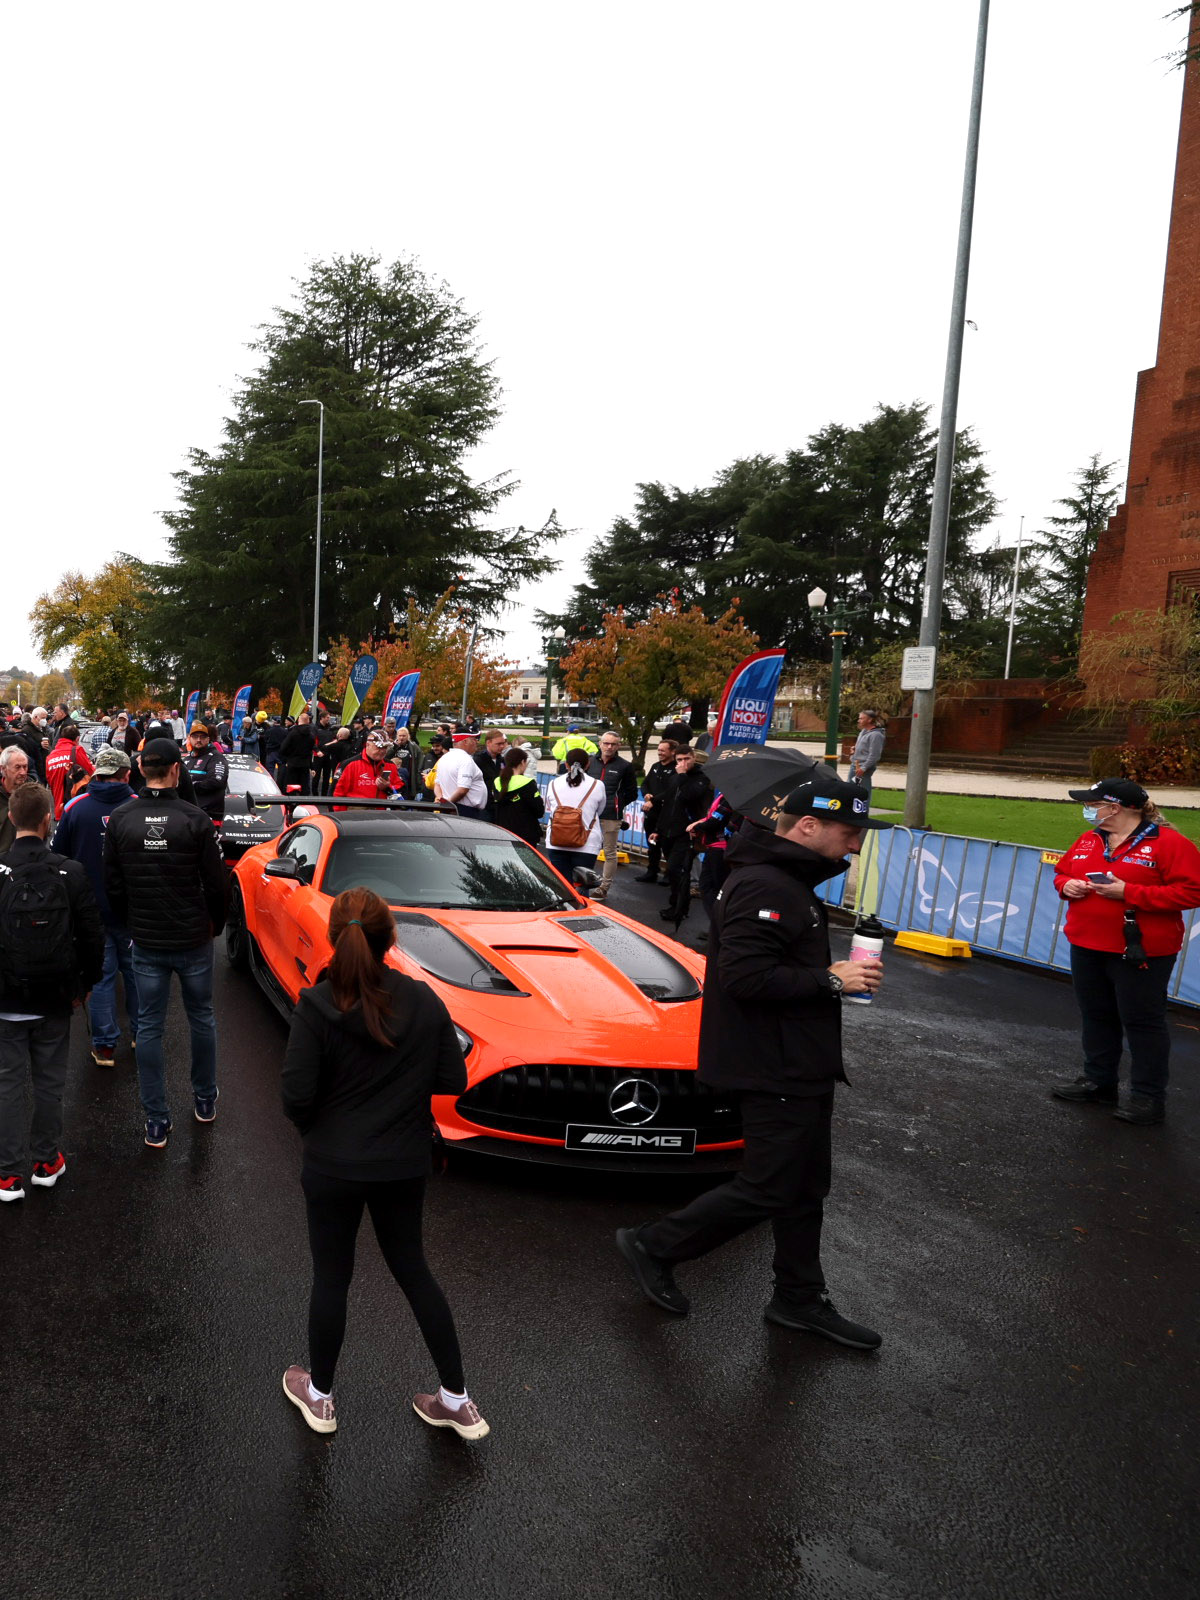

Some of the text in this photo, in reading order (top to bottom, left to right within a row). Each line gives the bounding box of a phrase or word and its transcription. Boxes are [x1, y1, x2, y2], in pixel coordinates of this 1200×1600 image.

[735, 699, 767, 712] LIQUI
[733, 711, 766, 724] MOLY
[729, 724, 751, 732] MOTOR
[223, 814, 262, 822] APEX
[611, 1135, 682, 1147] AMG
